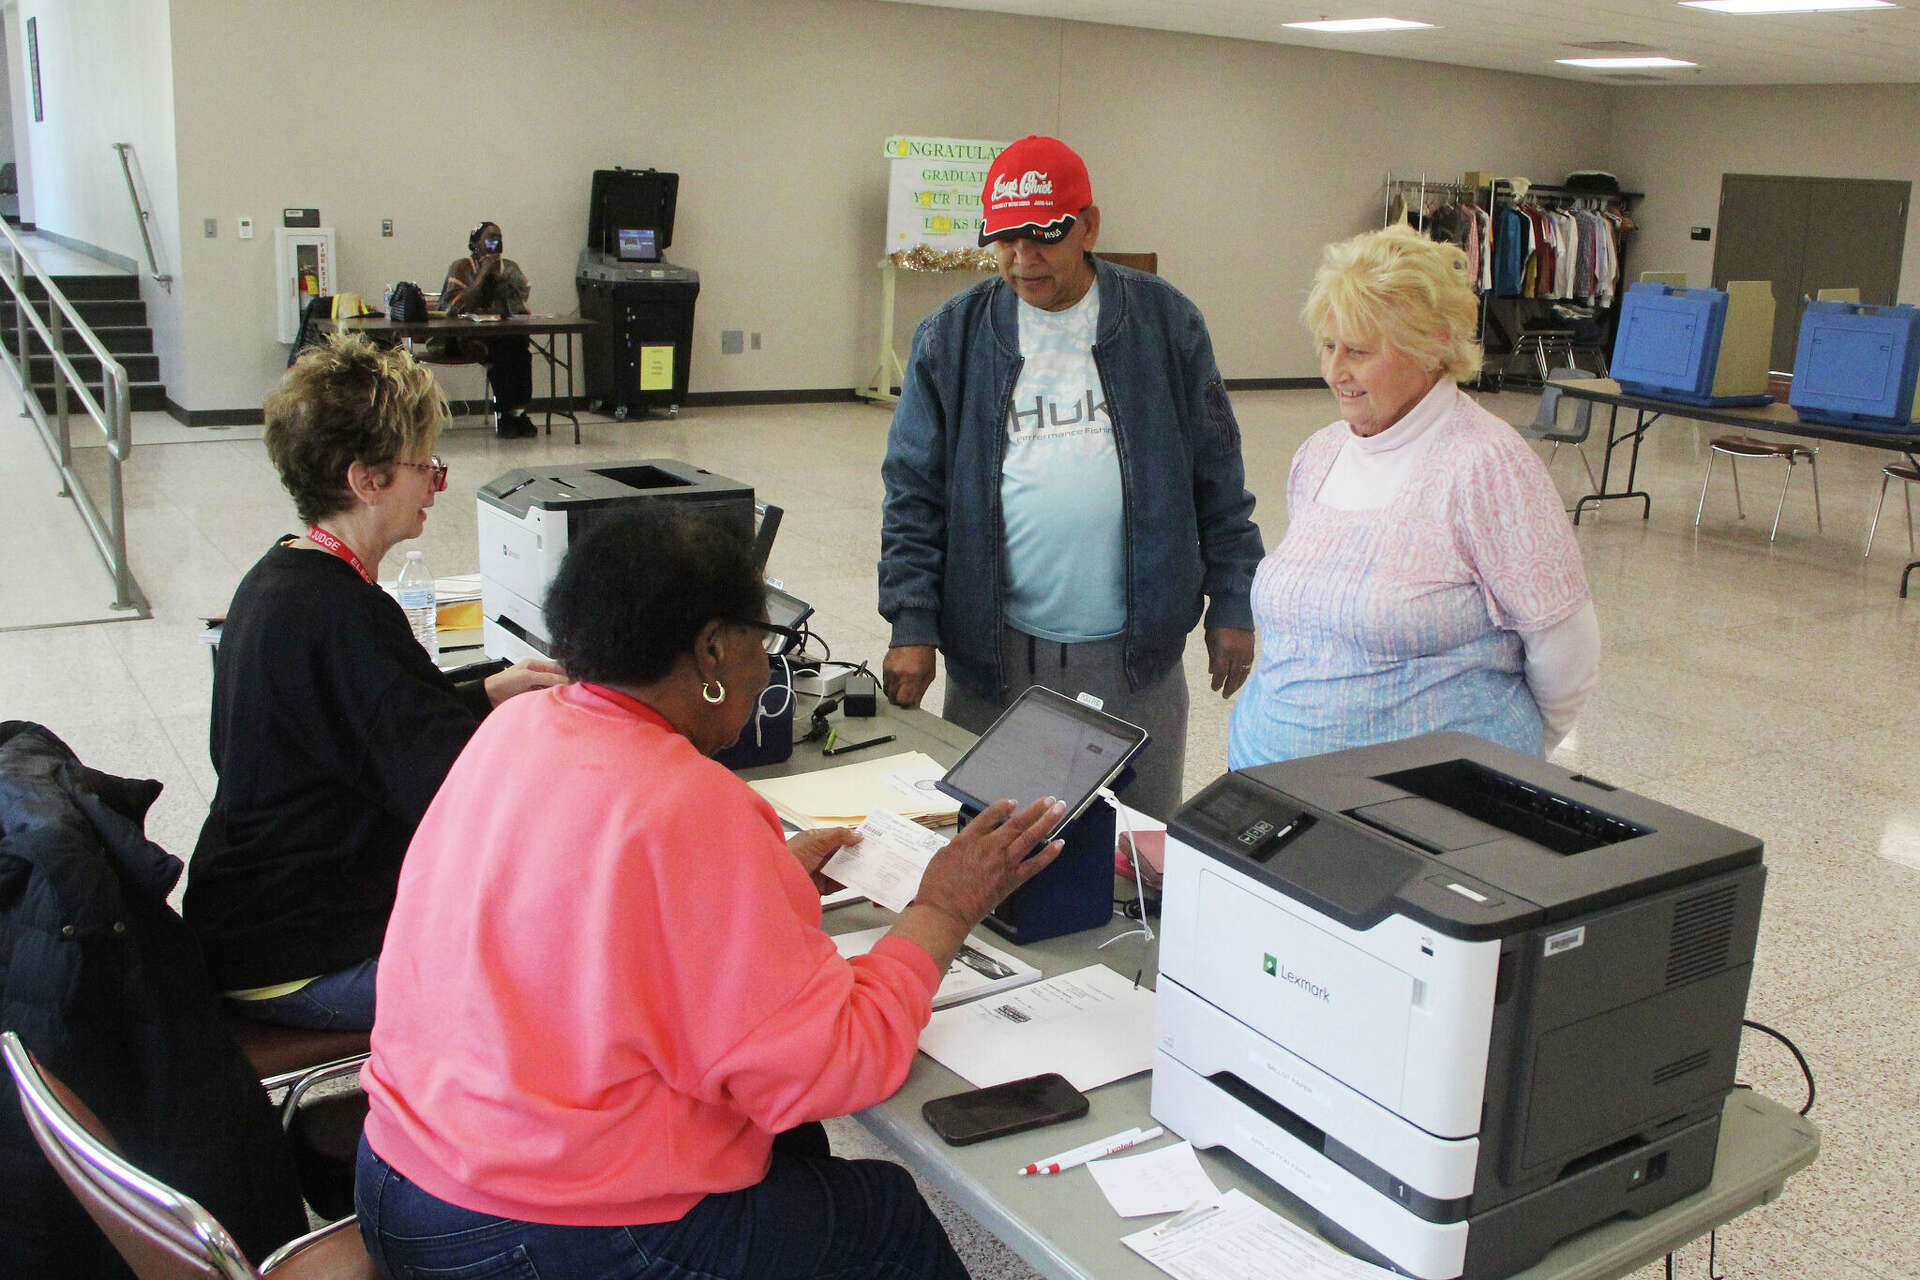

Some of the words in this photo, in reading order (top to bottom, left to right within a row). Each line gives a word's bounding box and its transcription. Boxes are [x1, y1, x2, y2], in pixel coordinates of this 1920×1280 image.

[886, 140, 1005, 160] CNGRATULA
[922, 169, 988, 182] GRADUAT
[913, 191, 951, 205] YUR
[957, 194, 983, 206] FUT
[924, 216, 969, 231] LKS
[1281, 963, 1330, 1004] Lexmark
[1398, 1184, 1404, 1197] 1
